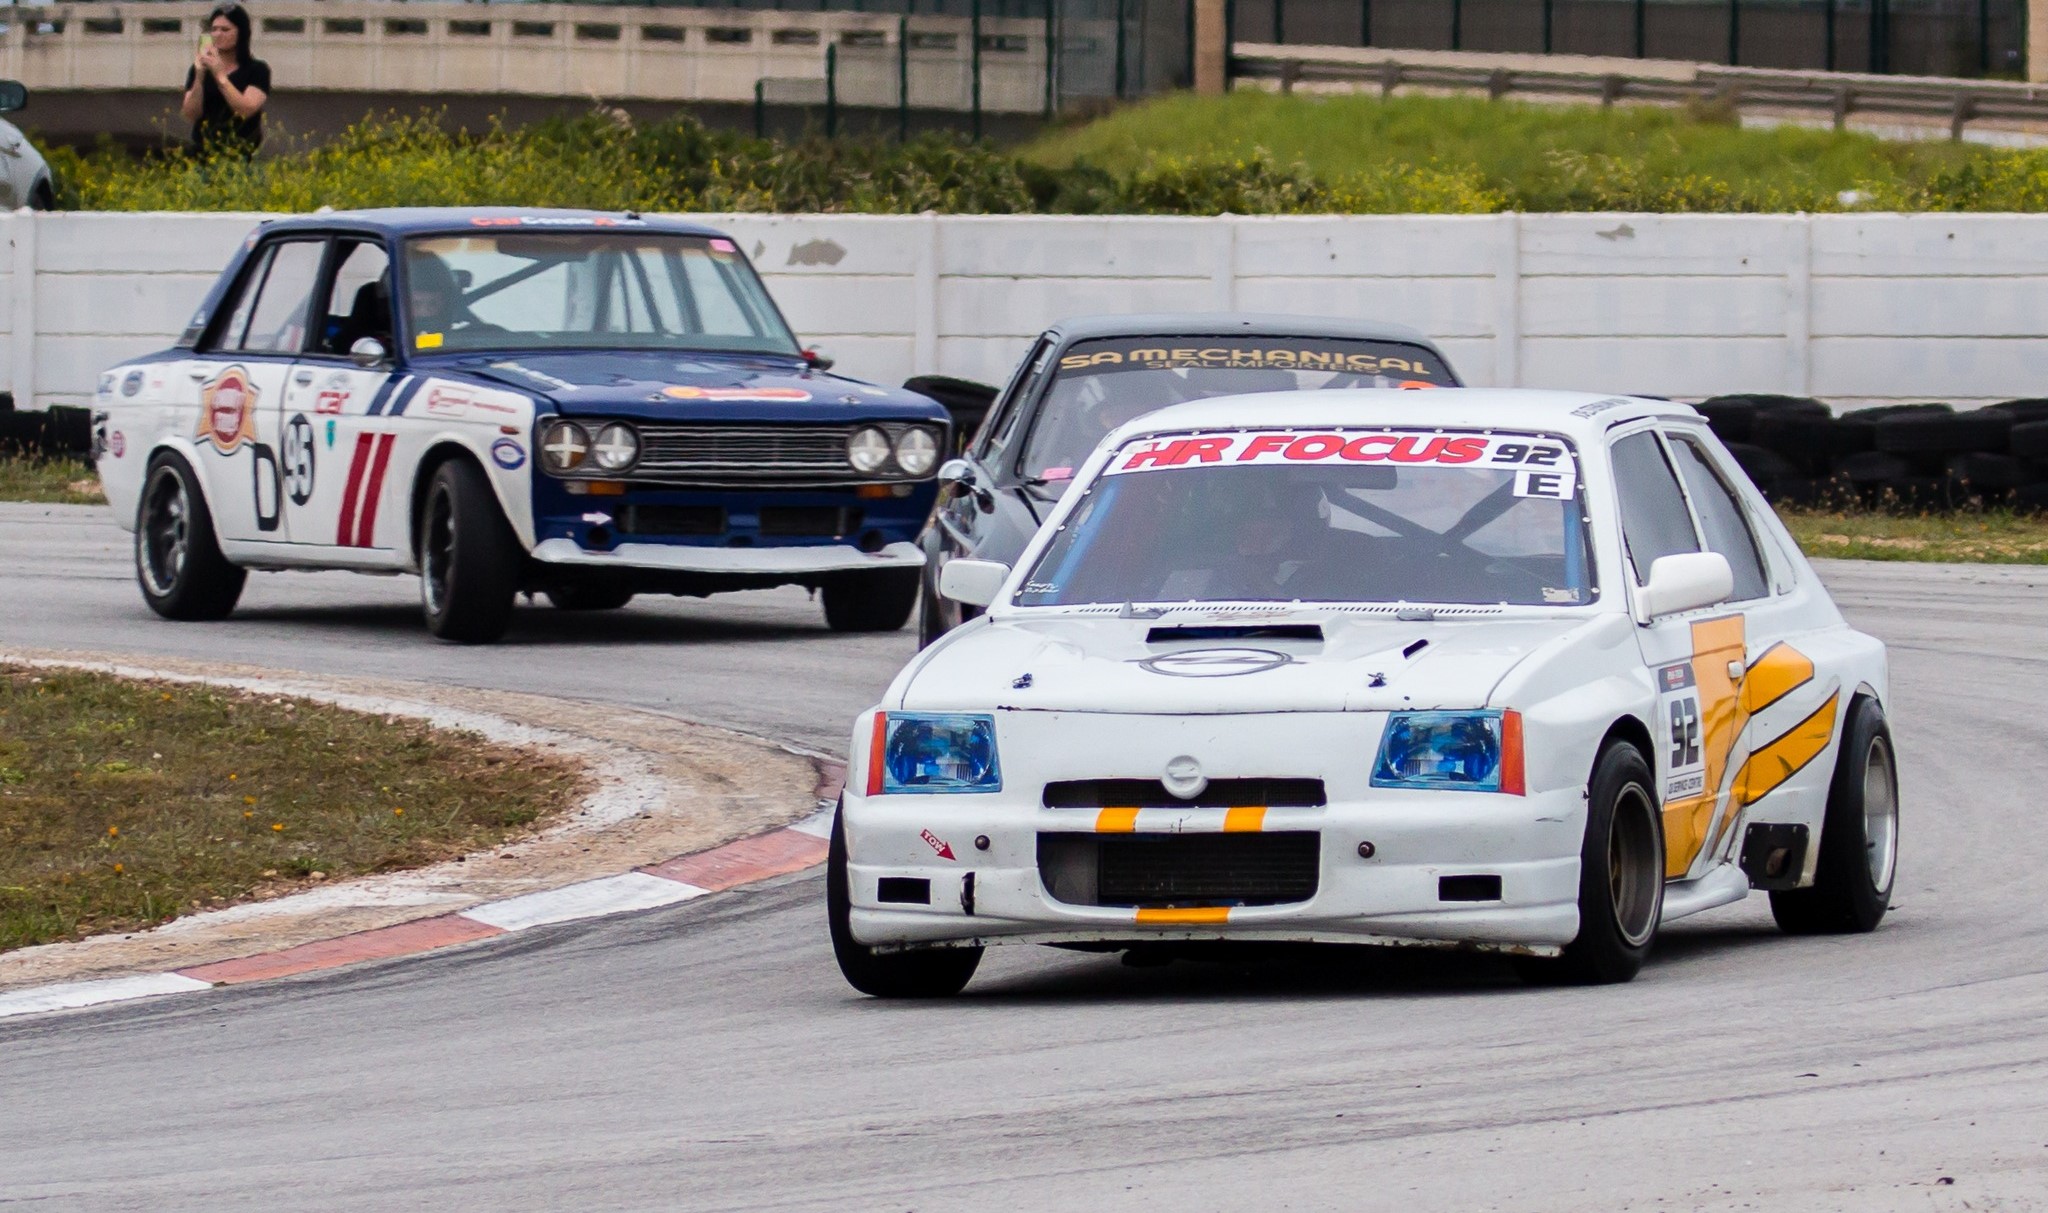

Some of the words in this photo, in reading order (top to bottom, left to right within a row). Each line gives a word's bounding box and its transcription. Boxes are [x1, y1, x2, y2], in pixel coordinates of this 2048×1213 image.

[1060, 351, 1124, 369] SA
[1129, 347, 1431, 375] MECHANICAL
[1122, 437, 1234, 471] HR
[1236, 434, 1489, 464] FOCUS
[1491, 443, 1563, 466] 92
[254, 443, 281, 532] D
[1527, 473, 1562, 497] E
[1670, 696, 1700, 769] 92
[923, 827, 946, 852] TOW
